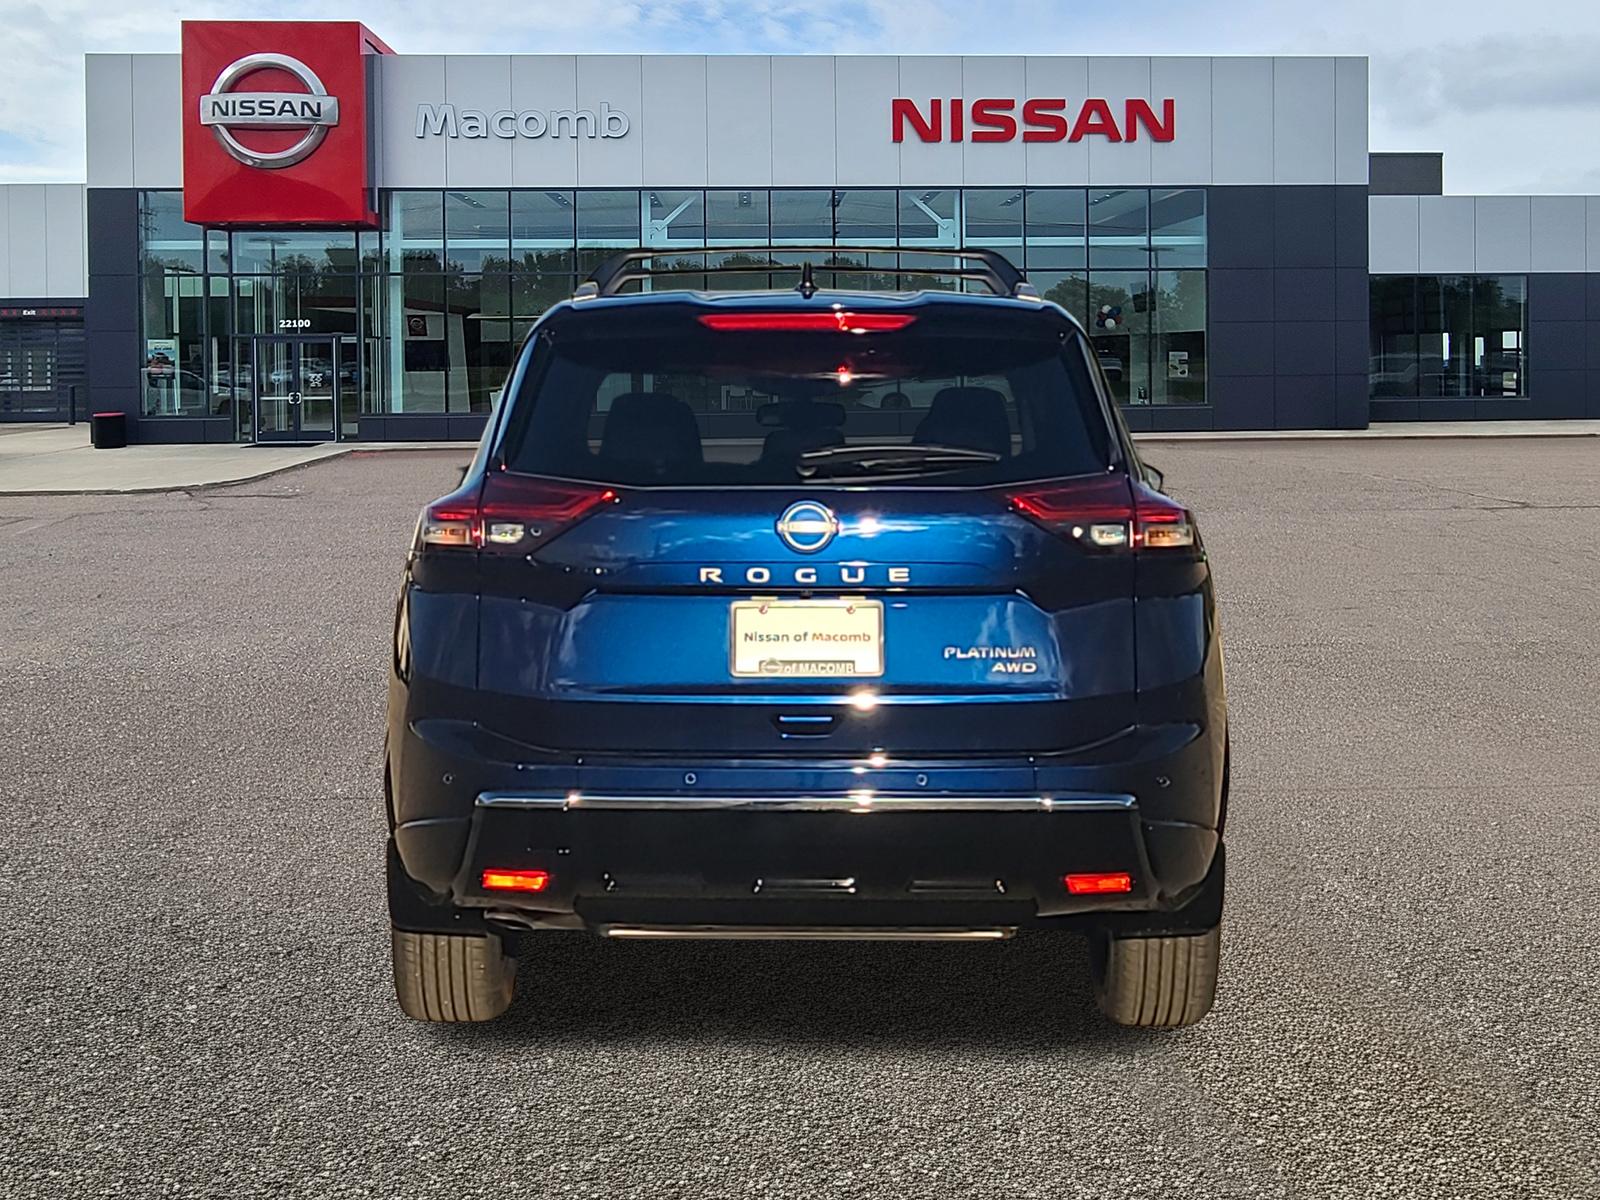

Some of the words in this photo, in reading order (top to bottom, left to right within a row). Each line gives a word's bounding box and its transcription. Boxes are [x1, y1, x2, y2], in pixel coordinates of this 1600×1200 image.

[211, 100, 322, 118] NISSAN
[415, 102, 630, 139] Macomb
[892, 98, 1175, 143] NISSAN
[279, 319, 311, 328] 22100
[700, 567, 910, 583] ROGUE
[744, 631, 789, 642] Nissan
[793, 631, 809, 642] of
[812, 632, 871, 642] Macomb
[943, 646, 1036, 659] PLATINUM
[800, 662, 855, 674] MACOMB
[991, 661, 1037, 673] AWD
